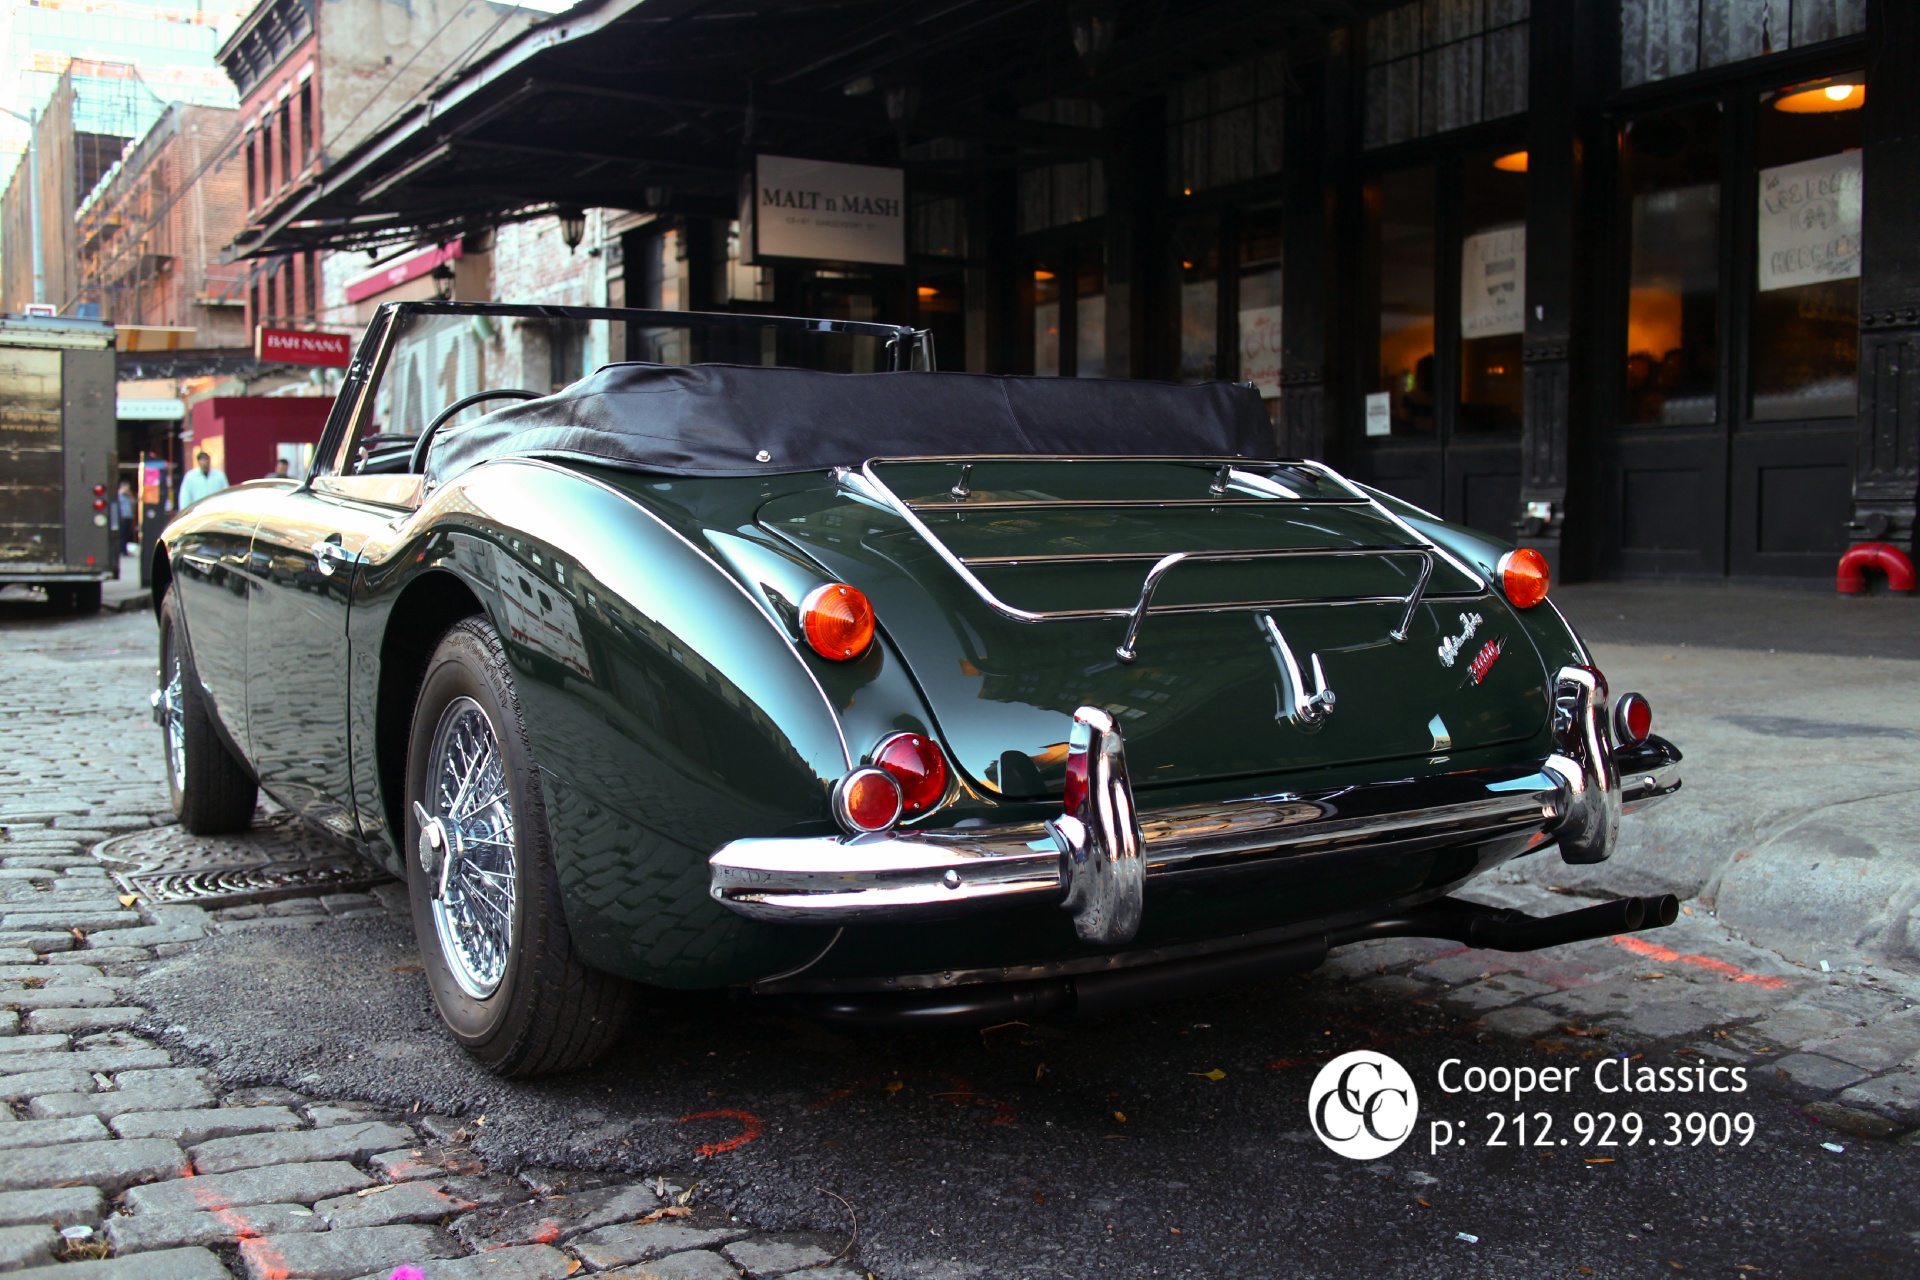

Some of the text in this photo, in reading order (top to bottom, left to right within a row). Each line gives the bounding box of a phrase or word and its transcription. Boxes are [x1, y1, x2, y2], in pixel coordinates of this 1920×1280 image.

[762, 187, 900, 217] MALT n MASH
[267, 334, 300, 349] BAR
